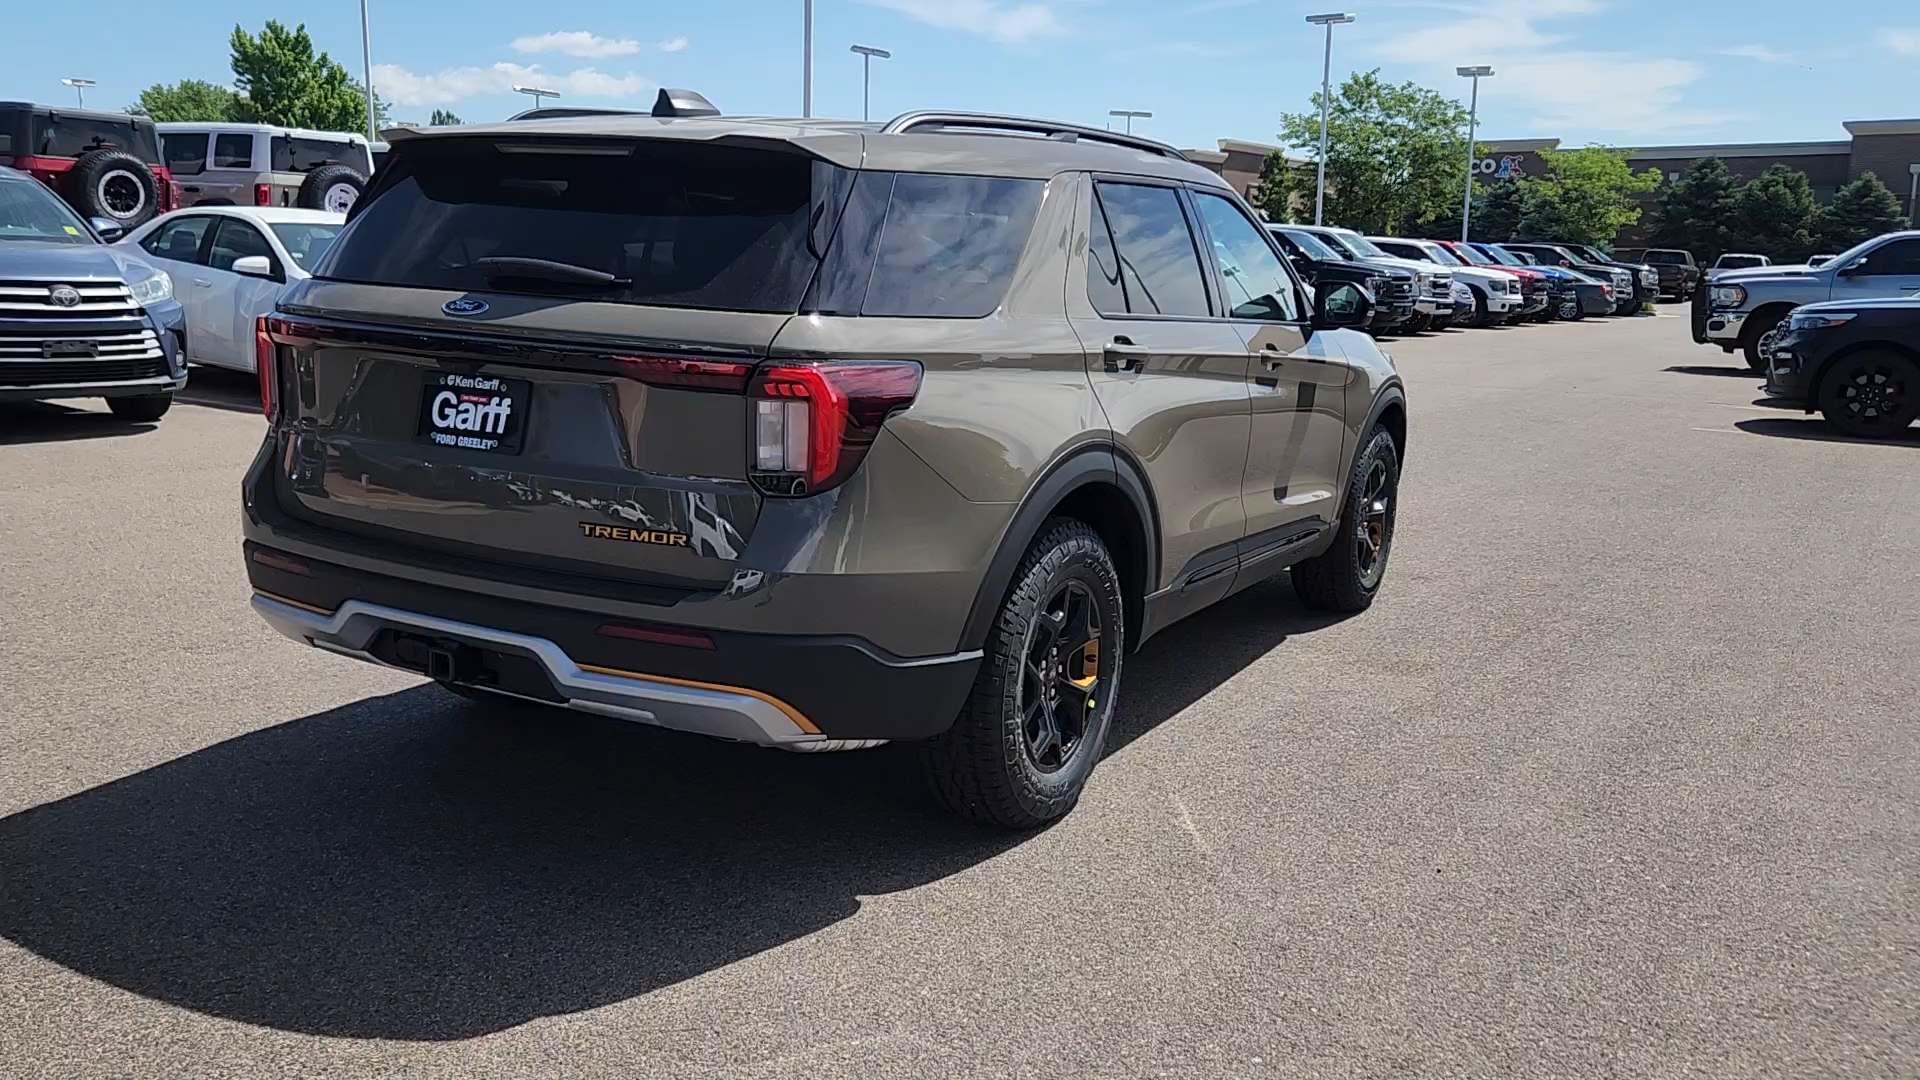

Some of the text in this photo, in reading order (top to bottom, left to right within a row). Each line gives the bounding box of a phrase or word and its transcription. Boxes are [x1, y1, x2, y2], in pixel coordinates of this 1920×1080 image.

[449, 300, 479, 311] Ford
[455, 375, 474, 389] Ken
[474, 377, 500, 391] Garff
[431, 390, 512, 434] Garff
[435, 433, 493, 450] FORD GREELEY
[579, 523, 688, 547] TREMOR
